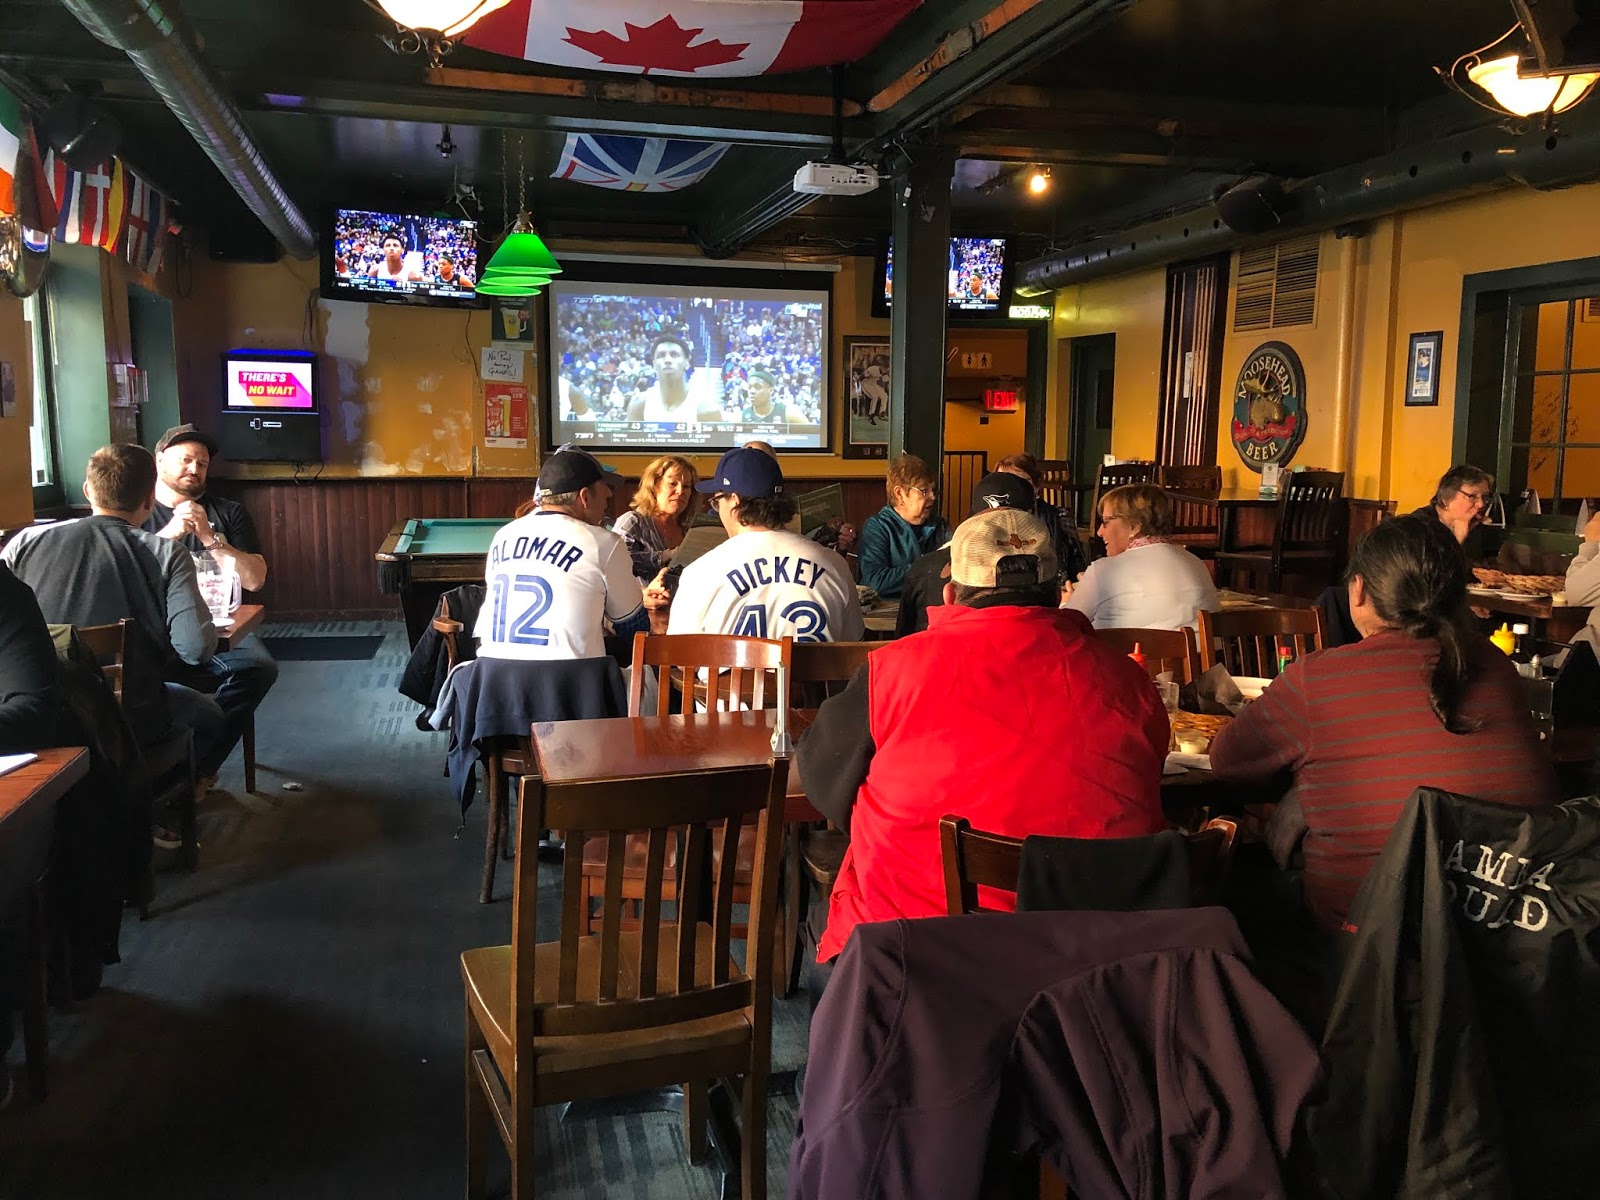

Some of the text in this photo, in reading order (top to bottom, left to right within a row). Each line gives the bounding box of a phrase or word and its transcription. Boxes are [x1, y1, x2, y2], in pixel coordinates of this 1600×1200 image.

[241, 372, 287, 383] THERE'S
[248, 385, 295, 396] NO WAIT
[1238, 356, 1291, 399] MOOSEHEAD
[993, 391, 1016, 408] EXIT
[1245, 442, 1279, 460] BEER
[492, 537, 583, 573] ALOMAR
[726, 556, 826, 597] DICKEY
[492, 574, 553, 646] 12
[732, 600, 829, 643] 43
